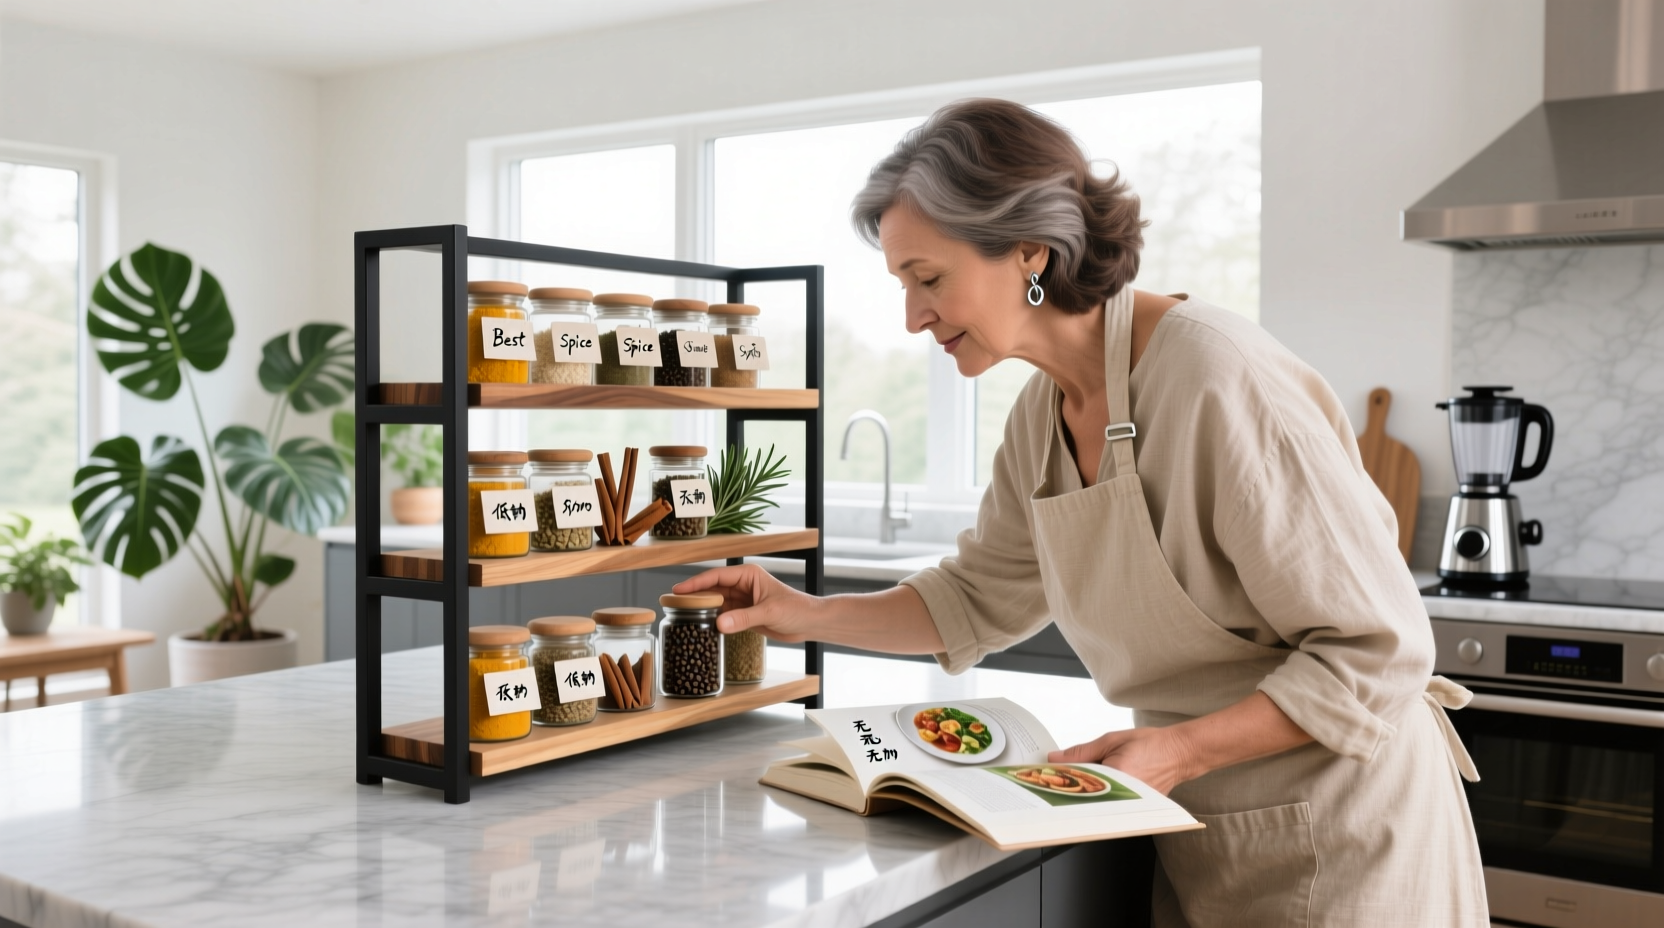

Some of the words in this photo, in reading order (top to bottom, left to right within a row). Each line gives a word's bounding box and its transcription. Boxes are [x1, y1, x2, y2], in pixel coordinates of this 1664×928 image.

[492, 327, 526, 348] Best
[559, 333, 593, 356] Spice
[622, 337, 654, 358] Spice
